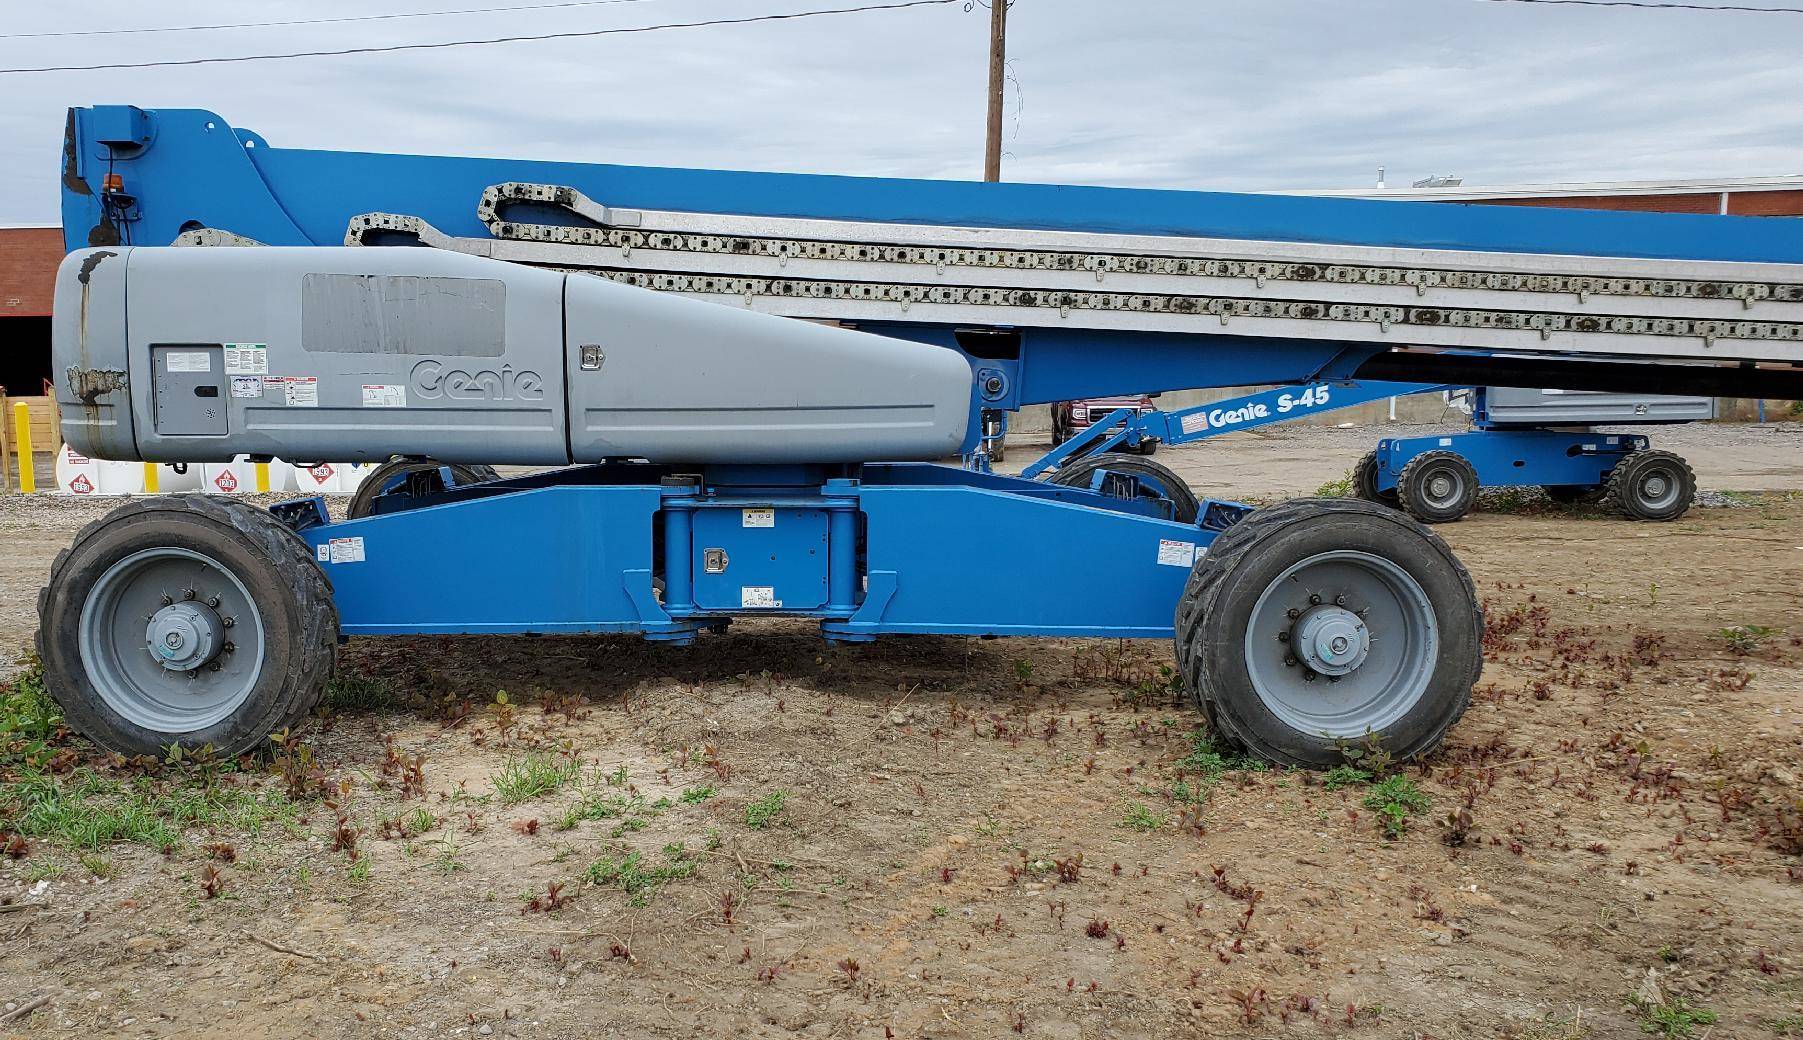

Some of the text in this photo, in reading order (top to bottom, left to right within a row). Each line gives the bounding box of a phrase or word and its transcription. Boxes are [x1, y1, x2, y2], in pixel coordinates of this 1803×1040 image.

[410, 359, 543, 401] Genie
[1208, 384, 1331, 428] Genie S-45
